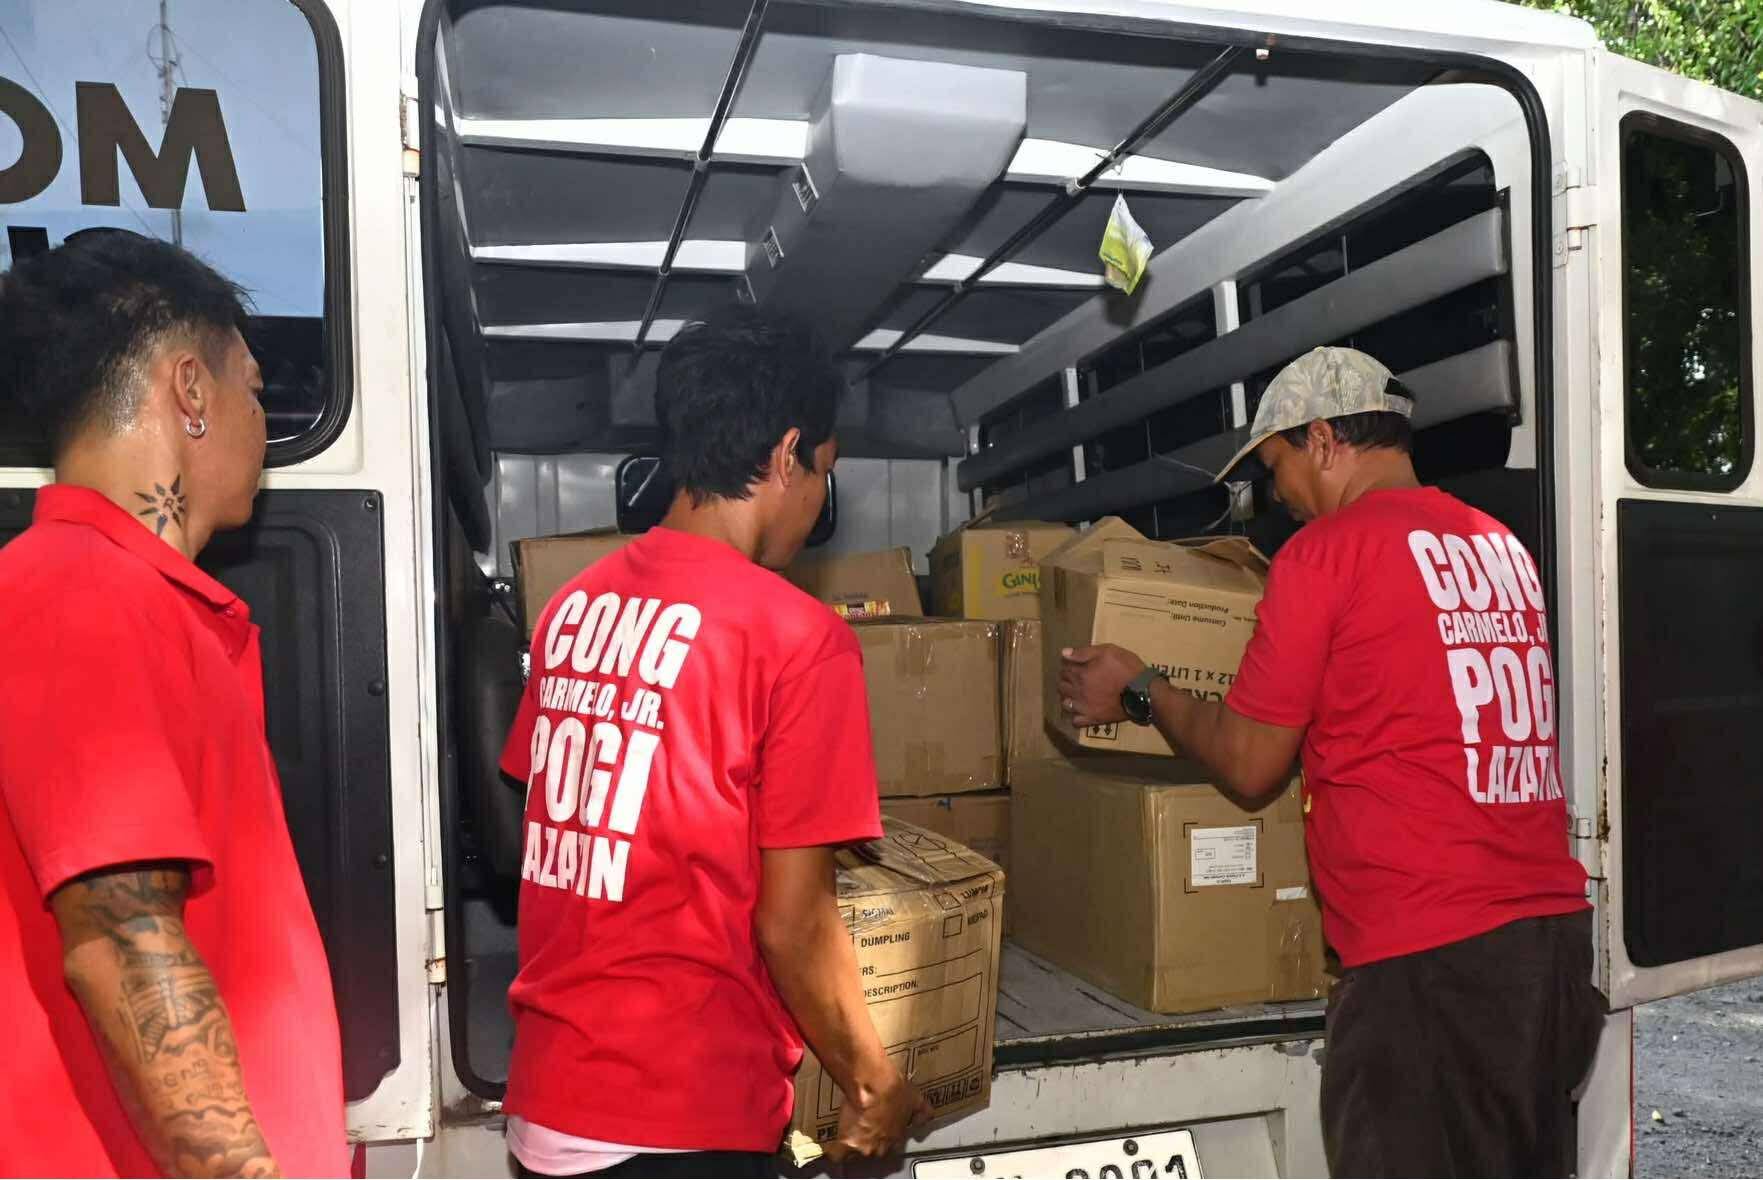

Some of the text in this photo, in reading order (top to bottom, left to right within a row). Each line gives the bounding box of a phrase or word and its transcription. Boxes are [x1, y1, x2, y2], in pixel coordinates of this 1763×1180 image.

[545, 590, 702, 689] CONG
[1437, 611, 1550, 646] CARMELO, J
[621, 687, 665, 730] JR.
[1447, 646, 1555, 744] POG
[525, 715, 661, 836] POGI
[861, 932, 911, 948] DUMPLING
[859, 965, 877, 976] RS:
